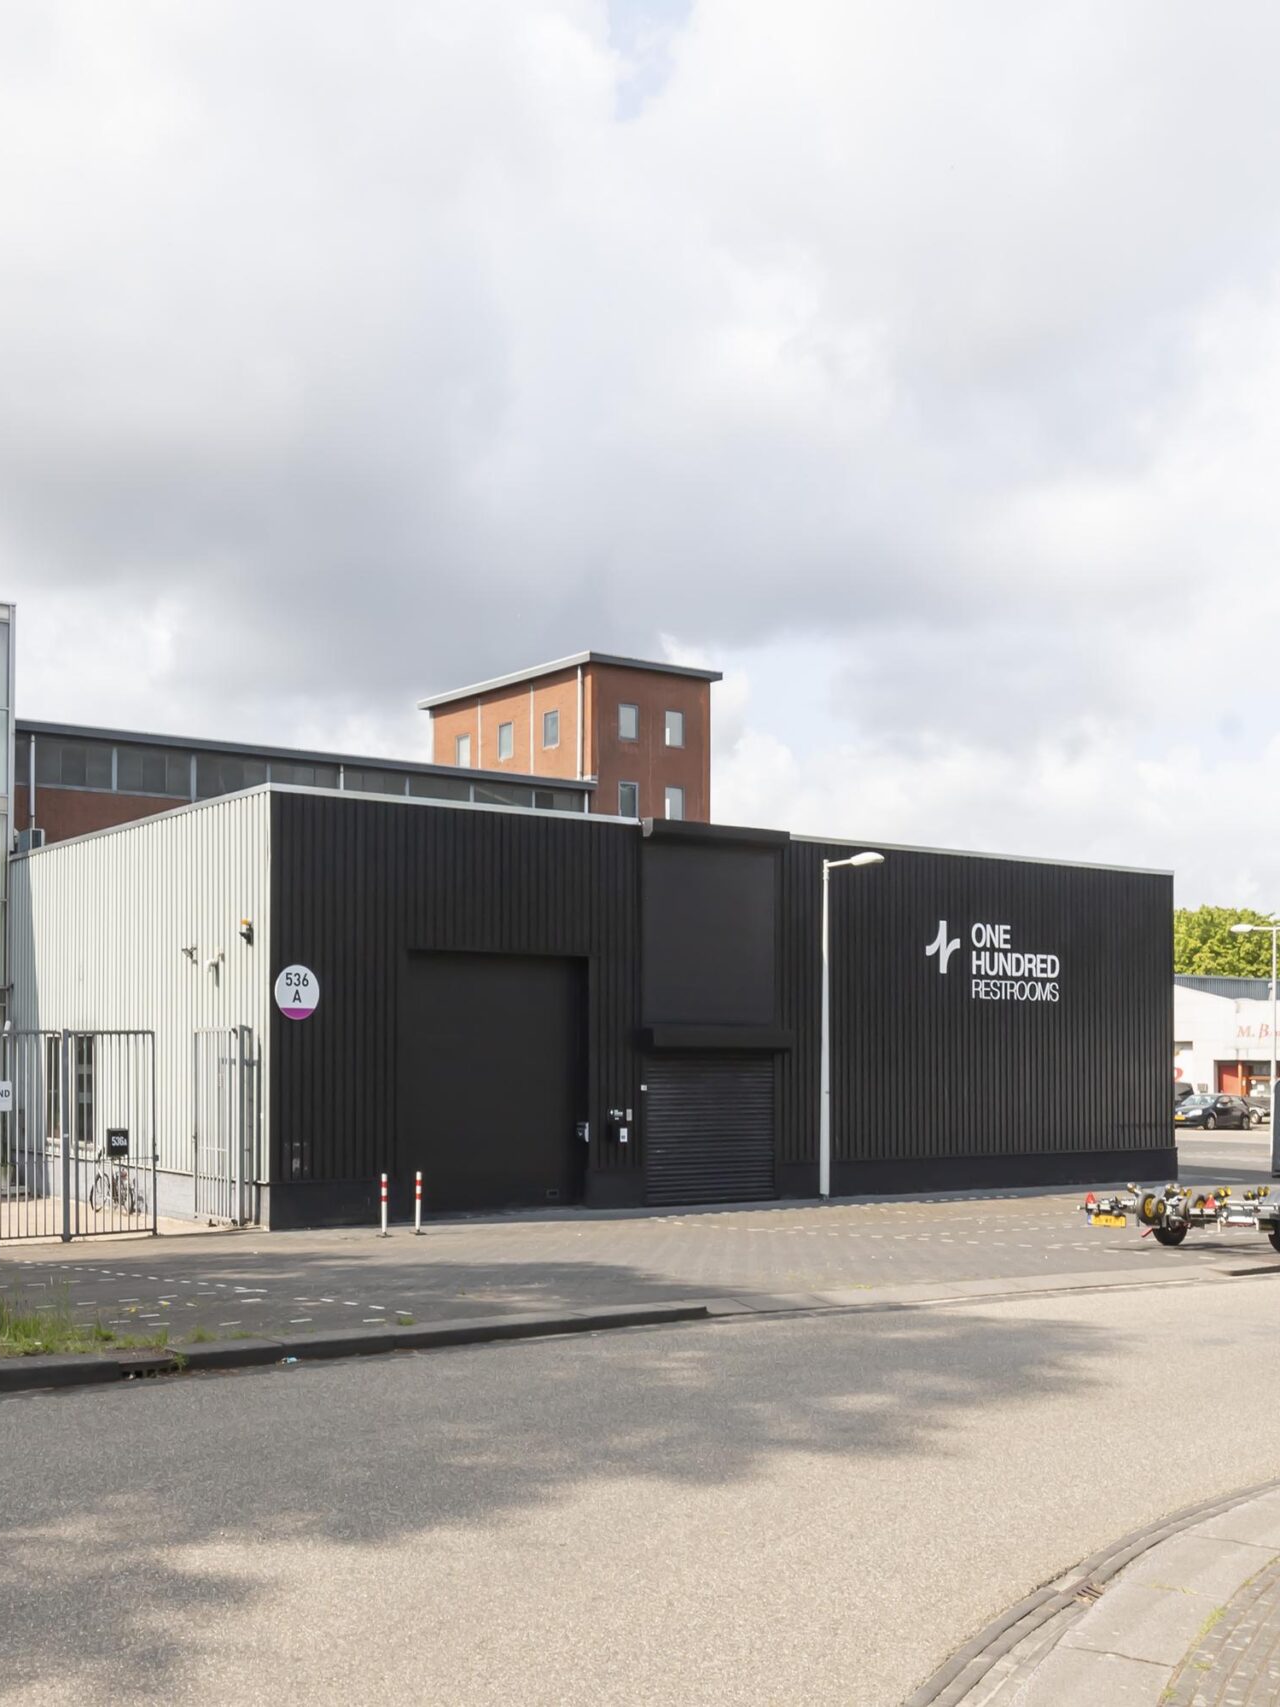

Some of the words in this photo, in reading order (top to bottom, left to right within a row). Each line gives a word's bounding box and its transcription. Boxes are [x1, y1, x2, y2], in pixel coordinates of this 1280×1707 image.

[971, 923, 1011, 949] ONE
[972, 951, 1060, 978] HUNDRED
[285, 972, 309, 987] 536
[972, 979, 1060, 1002] RESTROOMS
[292, 989, 302, 1003] A
